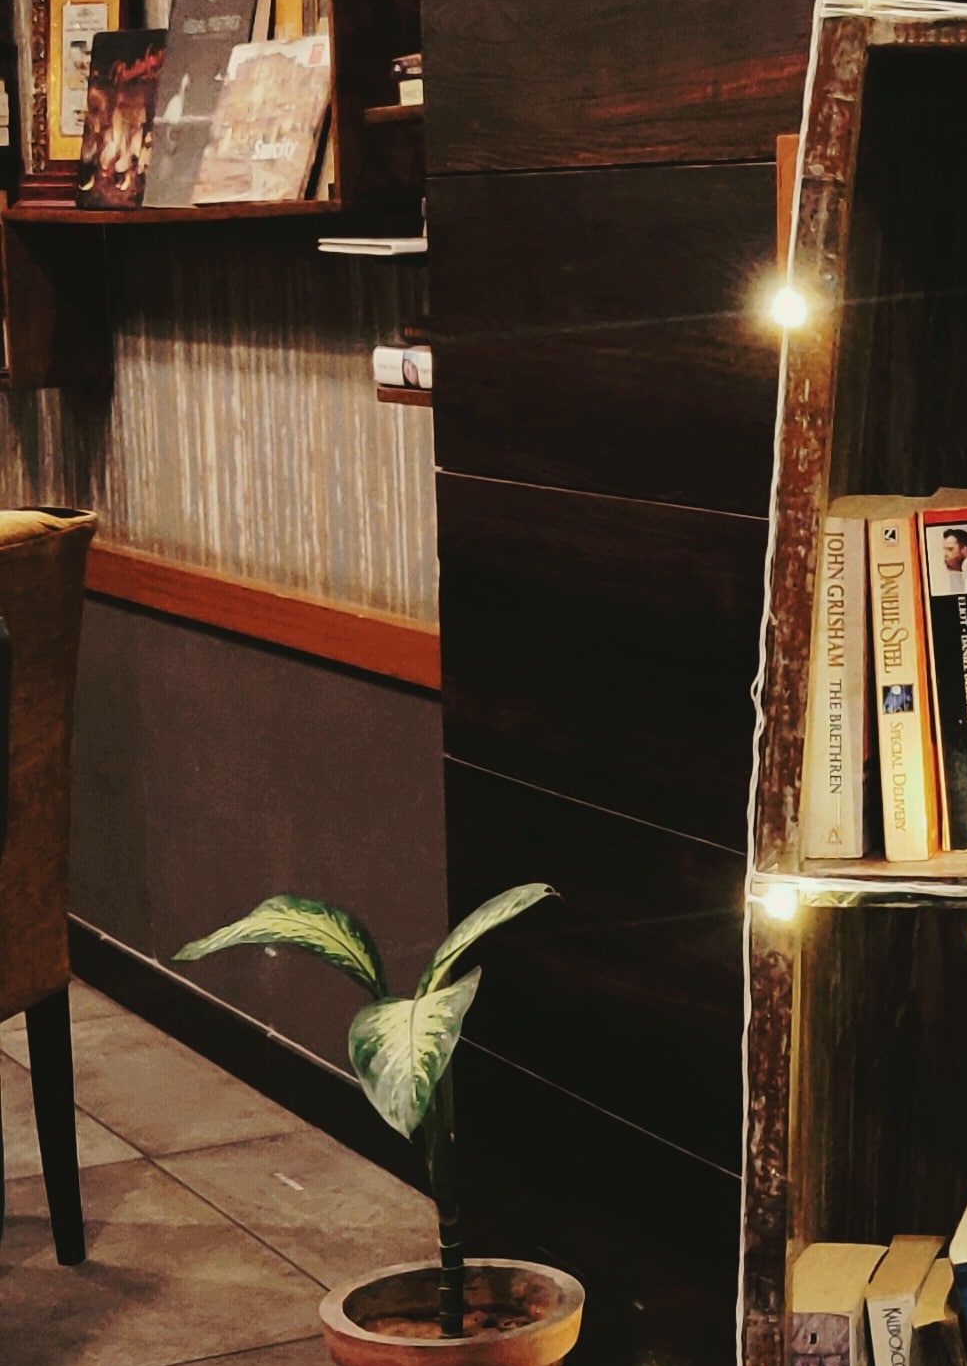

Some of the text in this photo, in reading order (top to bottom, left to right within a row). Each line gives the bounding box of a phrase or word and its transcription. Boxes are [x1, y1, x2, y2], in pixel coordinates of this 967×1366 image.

[824, 531, 844, 795] JOHN GRISHAM THE BRETHREN
[877, 561, 909, 674] DANIELLE STEEL
[889, 721, 906, 832] SPECIAL DELIVERY
